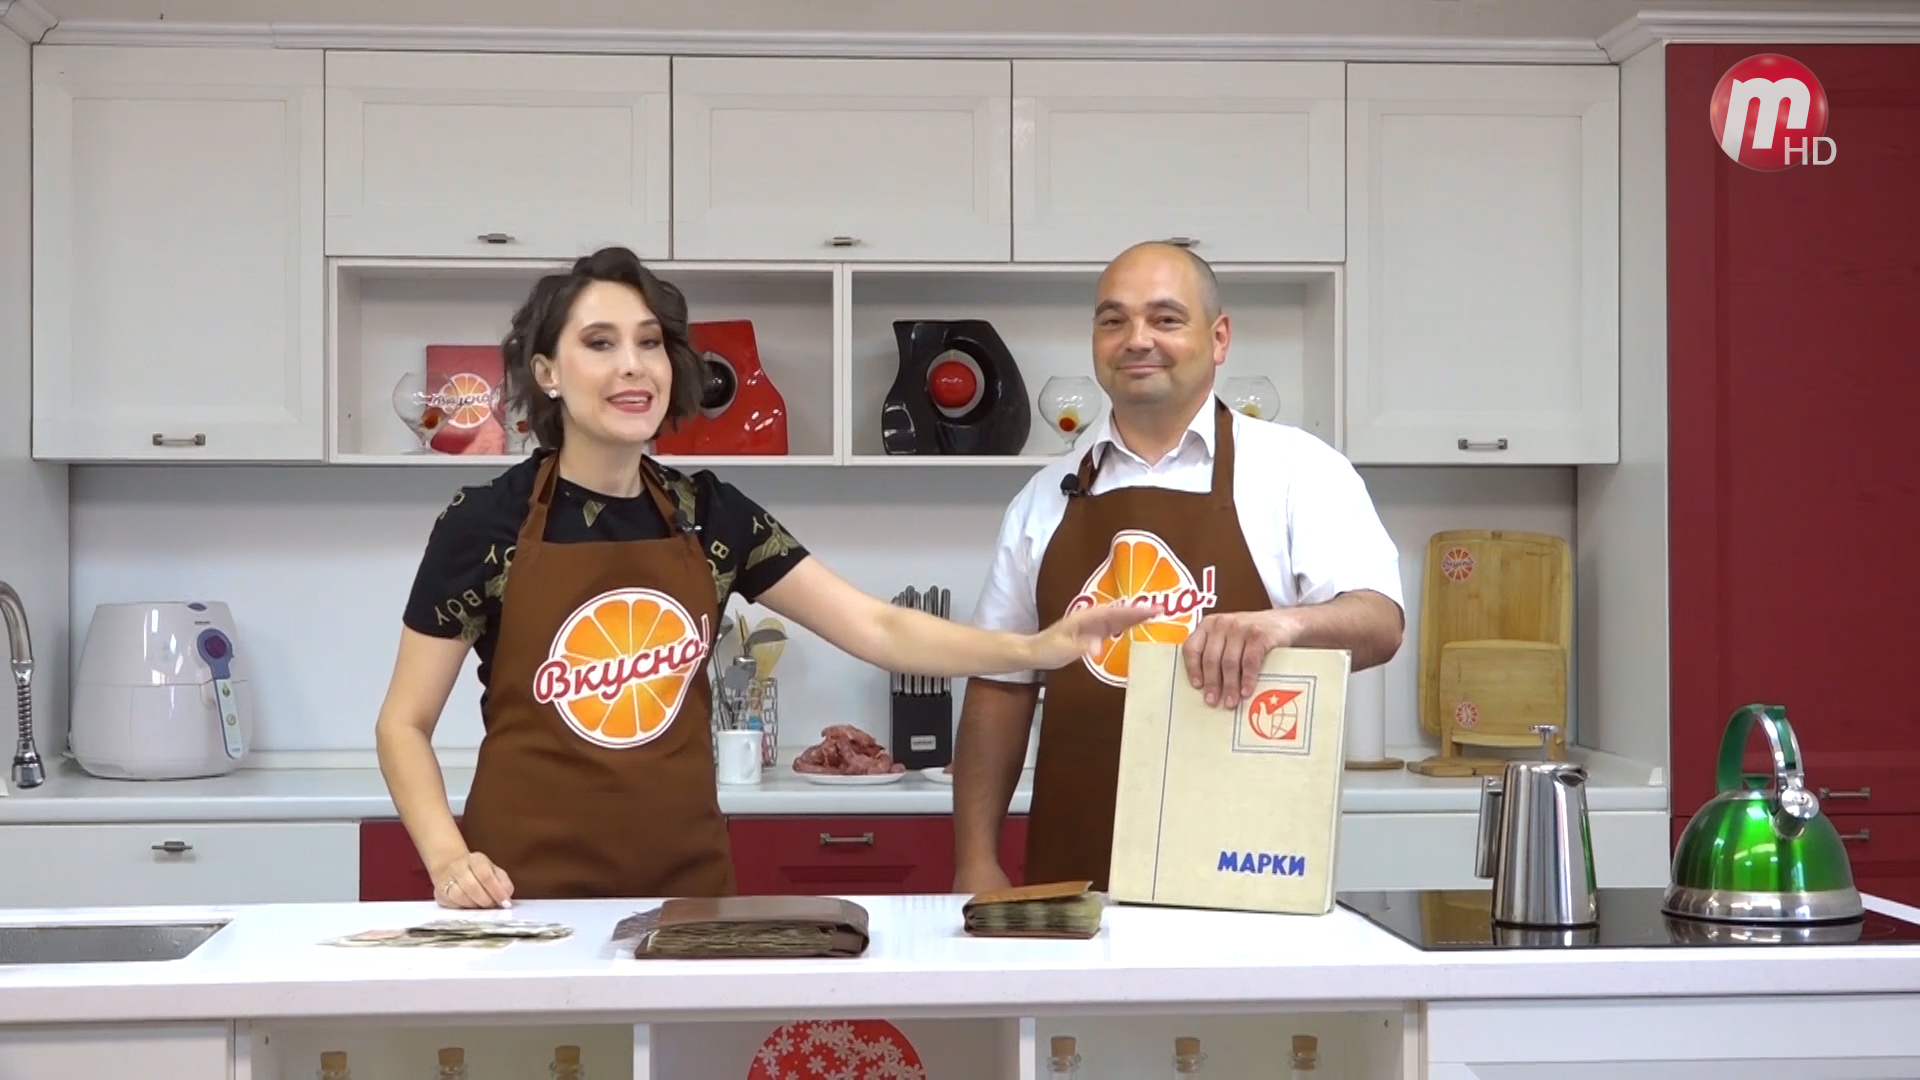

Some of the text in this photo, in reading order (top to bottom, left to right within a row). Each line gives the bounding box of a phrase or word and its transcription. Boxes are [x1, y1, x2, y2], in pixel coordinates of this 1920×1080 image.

[434, 588, 484, 626] BOY
[536, 614, 711, 702] Вкусно!
[1217, 850, 1306, 877] МАРКИ
